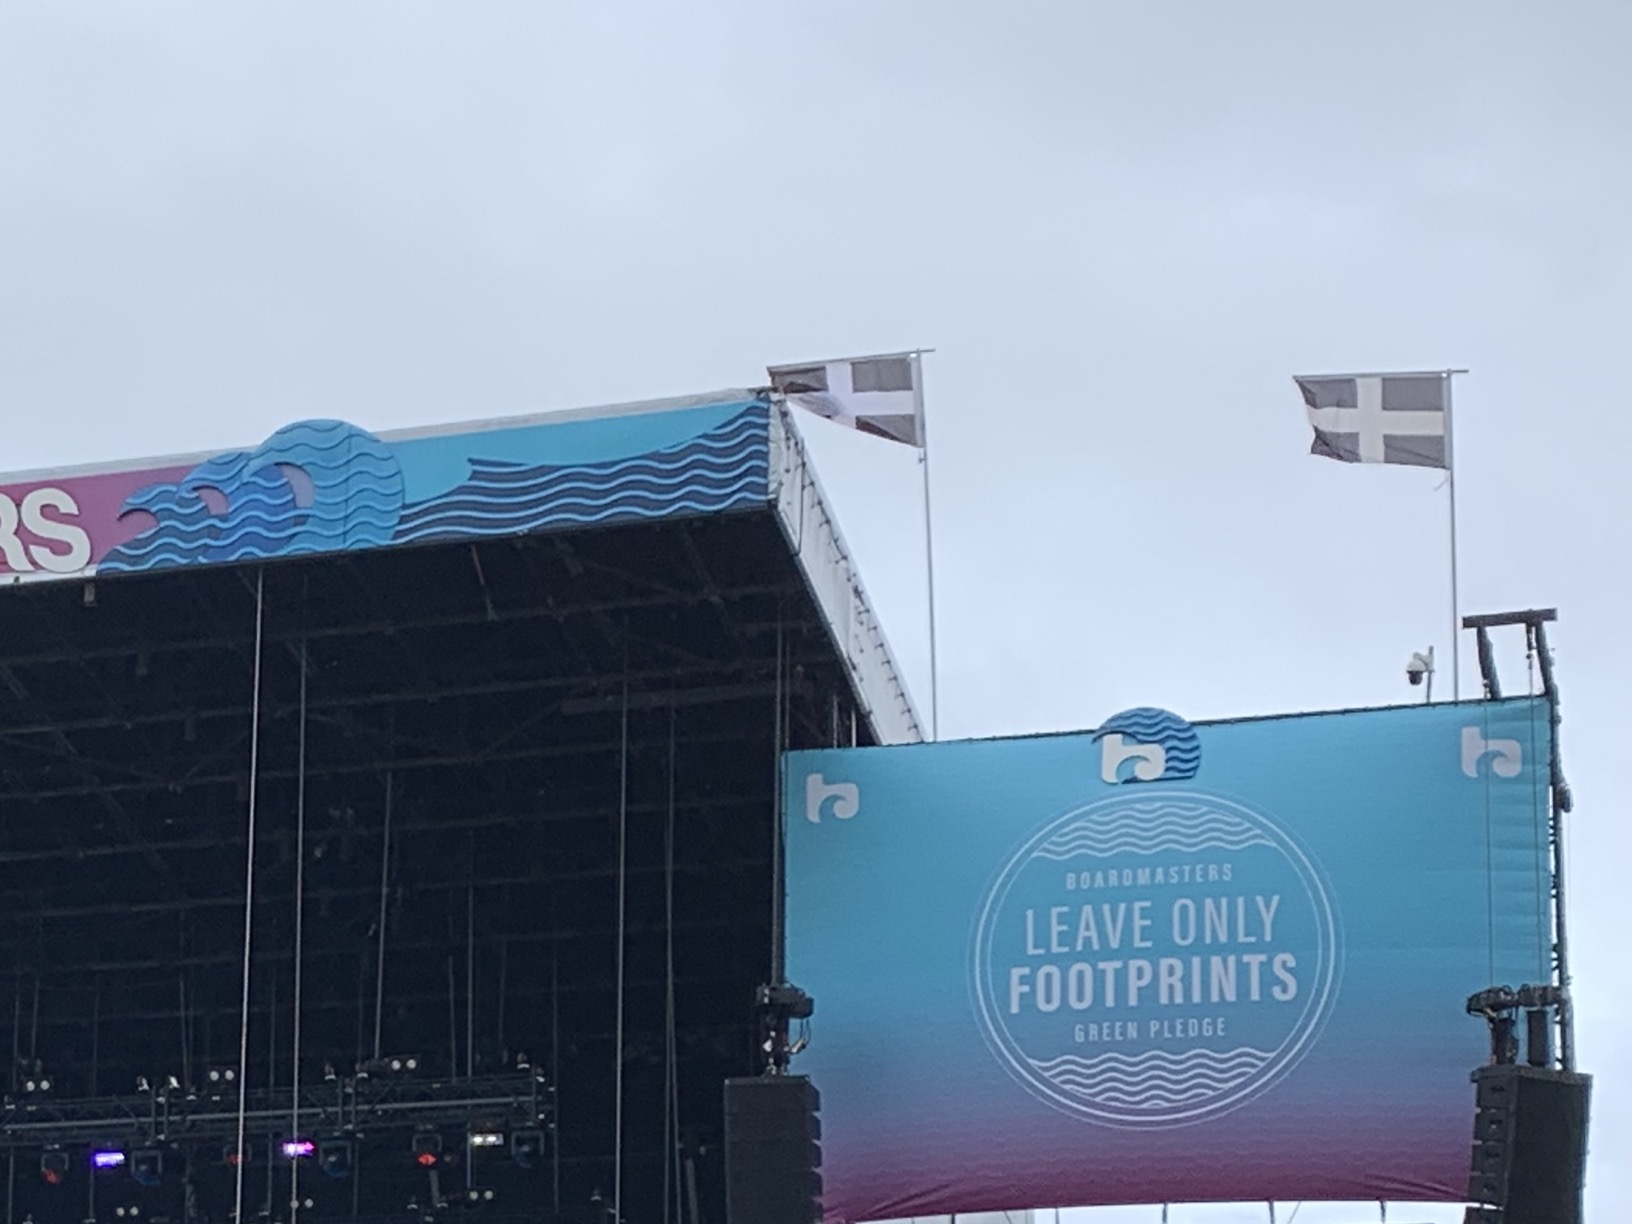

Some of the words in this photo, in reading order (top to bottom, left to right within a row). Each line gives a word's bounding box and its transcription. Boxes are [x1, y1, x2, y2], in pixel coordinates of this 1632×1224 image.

[1065, 863, 1234, 891] BOARDMASTERS
[1025, 900, 1153, 956] LEAVE
[1171, 893, 1282, 947] ONLY
[1008, 950, 1300, 1015] FOOTPRINTS
[1073, 1021, 1140, 1043] GREEN
[1149, 1016, 1228, 1040] PLEDGE
